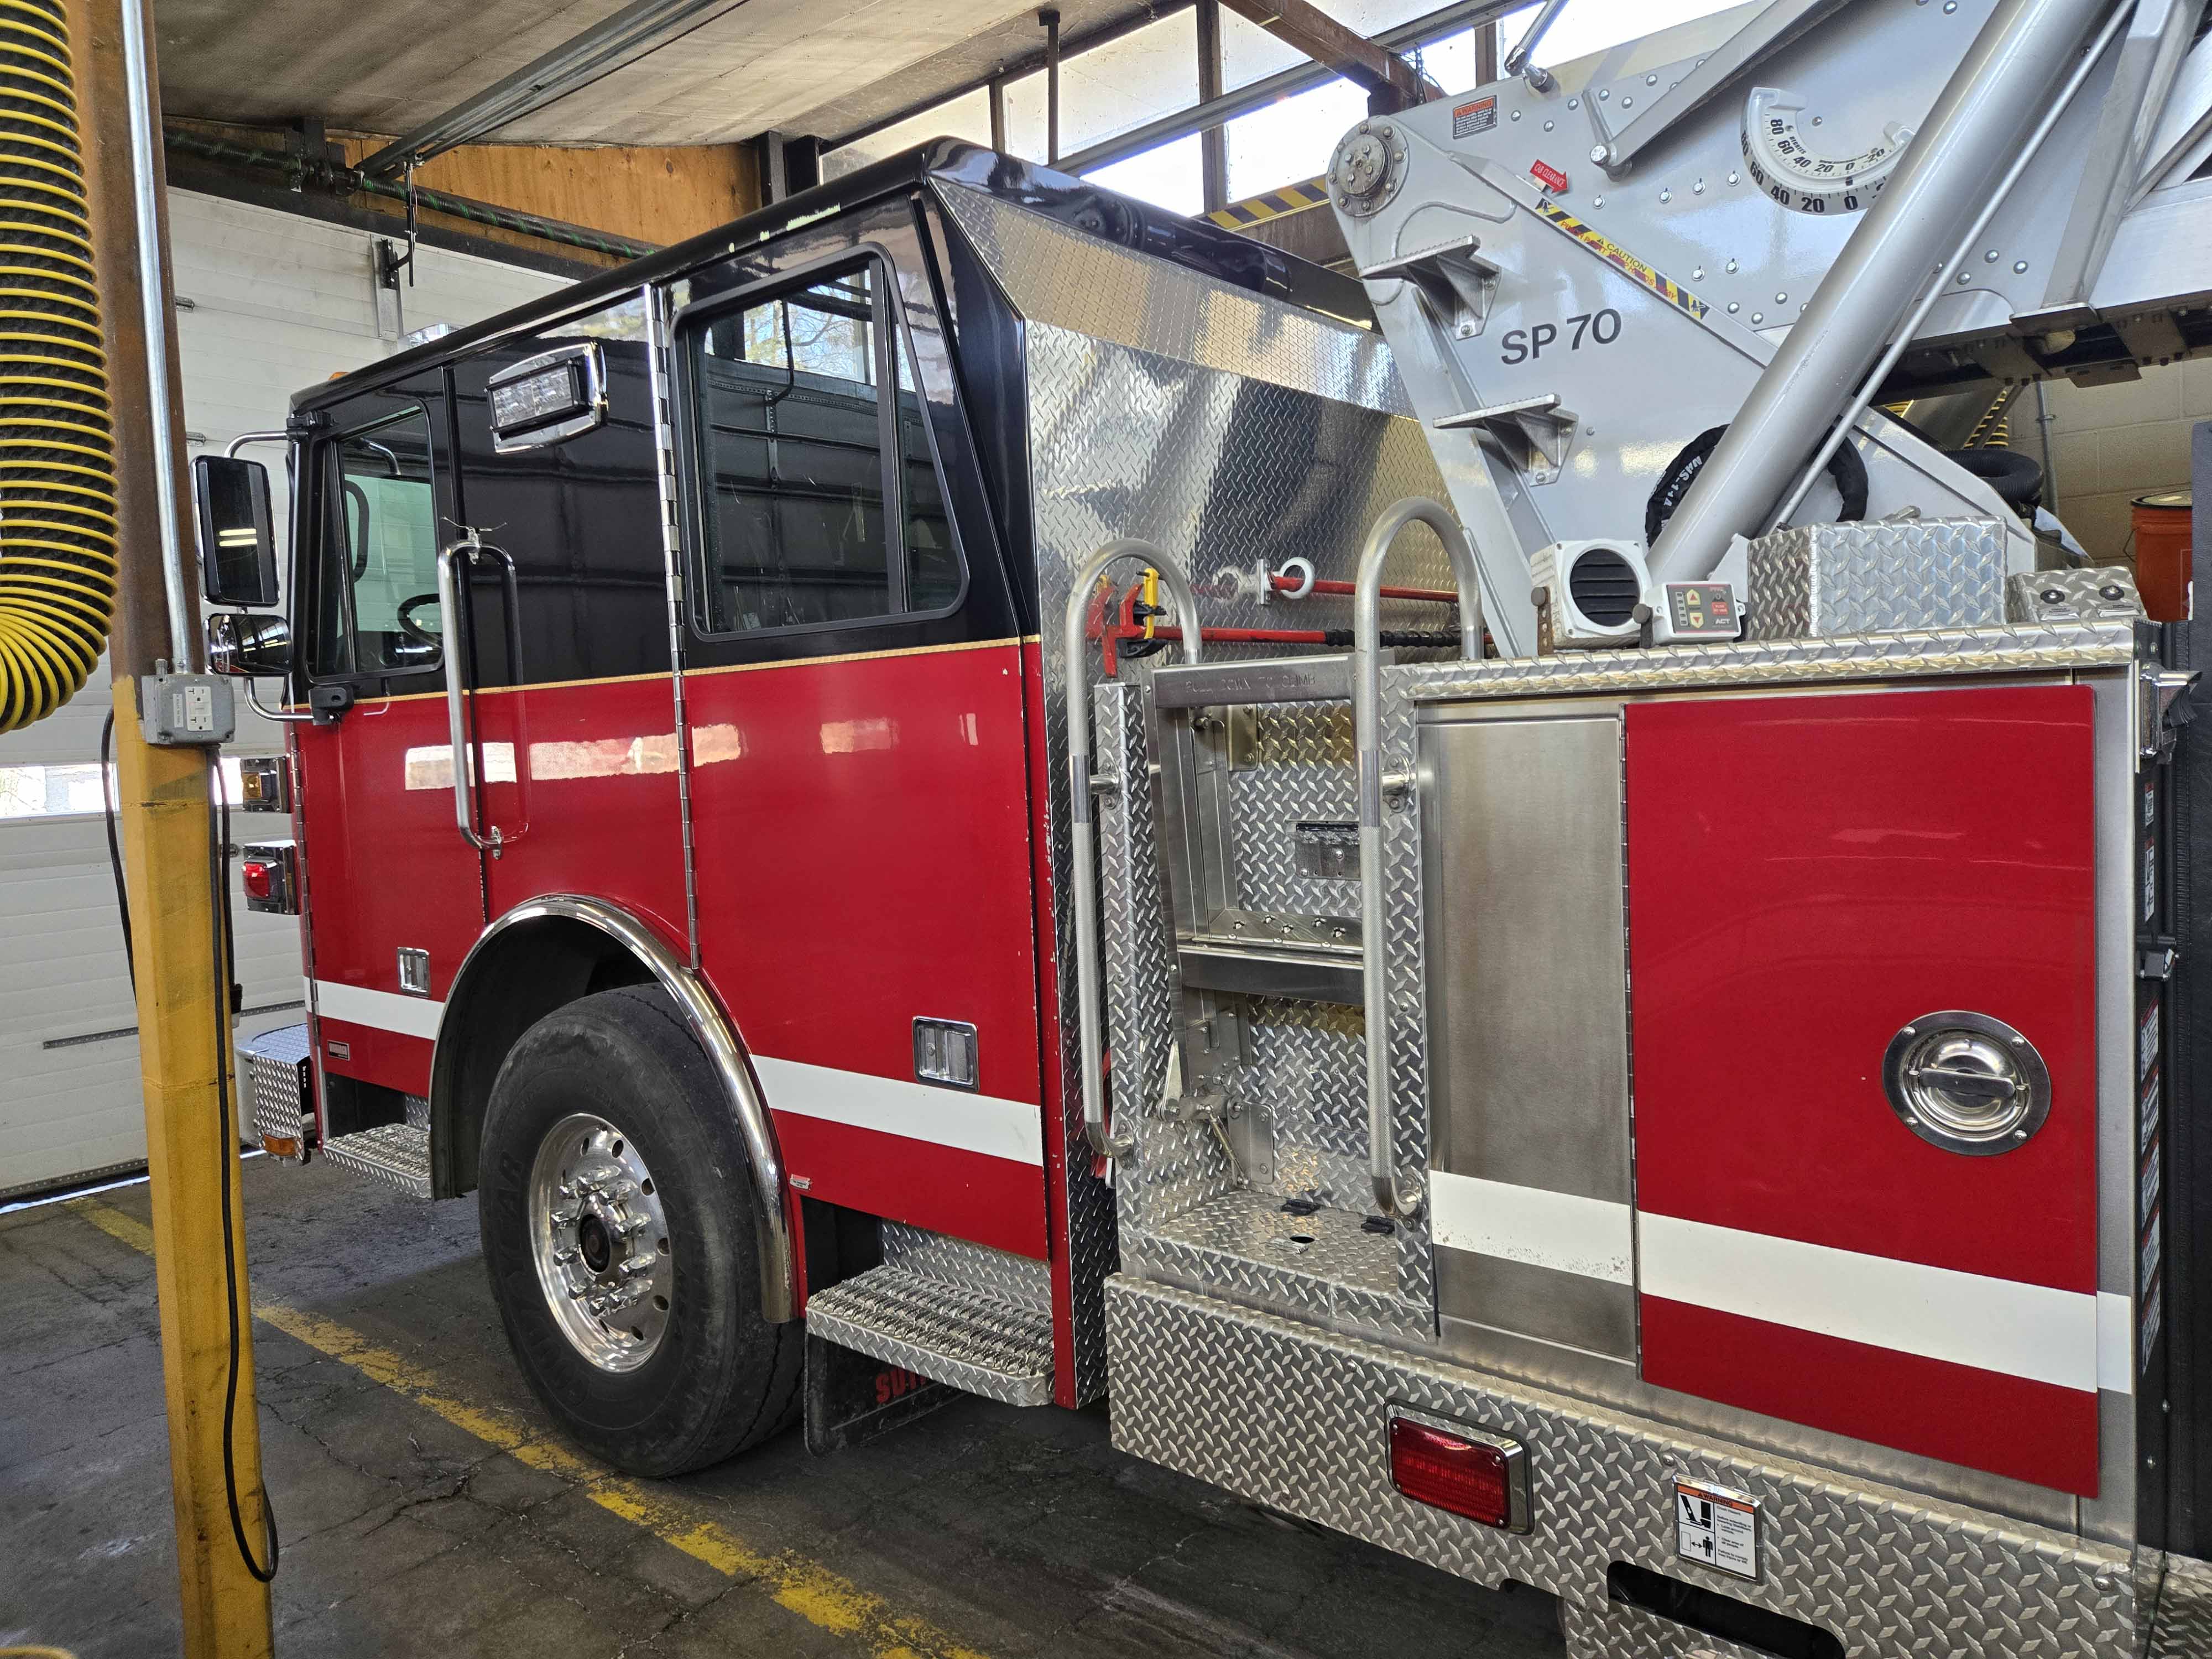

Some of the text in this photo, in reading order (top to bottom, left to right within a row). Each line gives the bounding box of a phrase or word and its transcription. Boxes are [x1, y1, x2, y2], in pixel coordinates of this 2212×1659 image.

[1462, 101, 1492, 114] WARNING
[1770, 119, 1784, 135] 80
[1777, 140, 1794, 155] 60
[1793, 156, 1812, 168] 40
[1814, 164, 1834, 173] 20
[1845, 162, 1855, 171] 0
[1750, 161, 1764, 186] 60
[1771, 186, 1790, 205] 40
[1844, 195, 1859, 211] 0
[1801, 197, 1825, 213] 20
[1607, 244, 1647, 272] CAUTION
[1501, 309, 1621, 365] SP 70
[1704, 1493, 1733, 1507] WARNING
